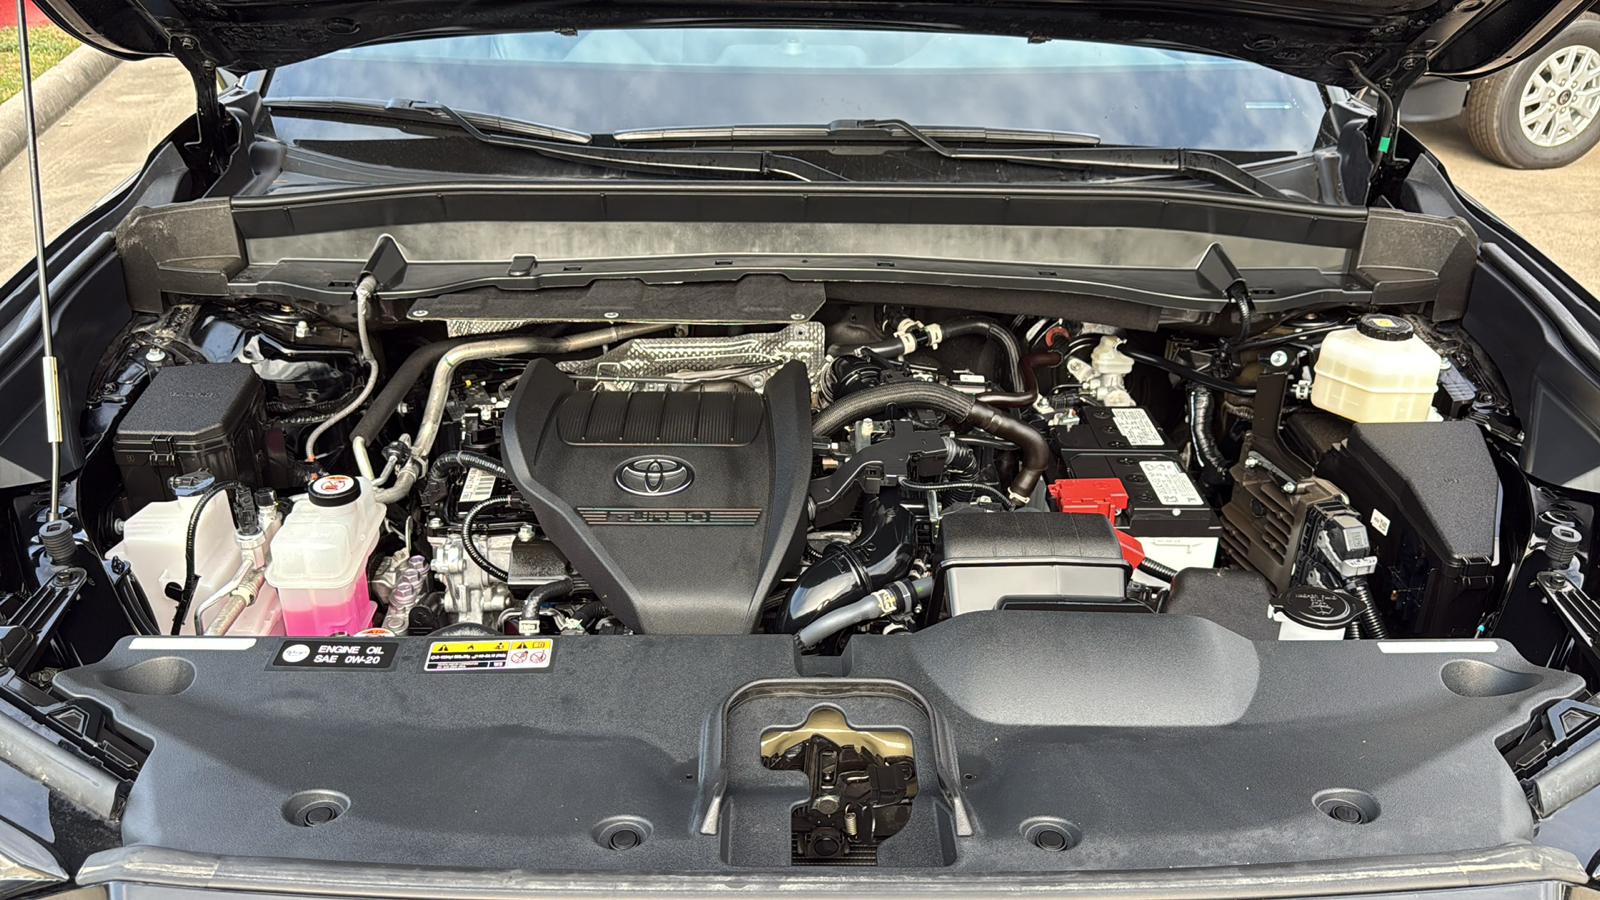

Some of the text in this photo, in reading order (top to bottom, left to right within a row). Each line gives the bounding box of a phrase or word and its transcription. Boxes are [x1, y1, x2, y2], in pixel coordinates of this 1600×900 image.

[317, 645, 361, 655] ENGINE
[365, 646, 385, 655] OIL
[313, 654, 381, 665] SAE 0W-20
